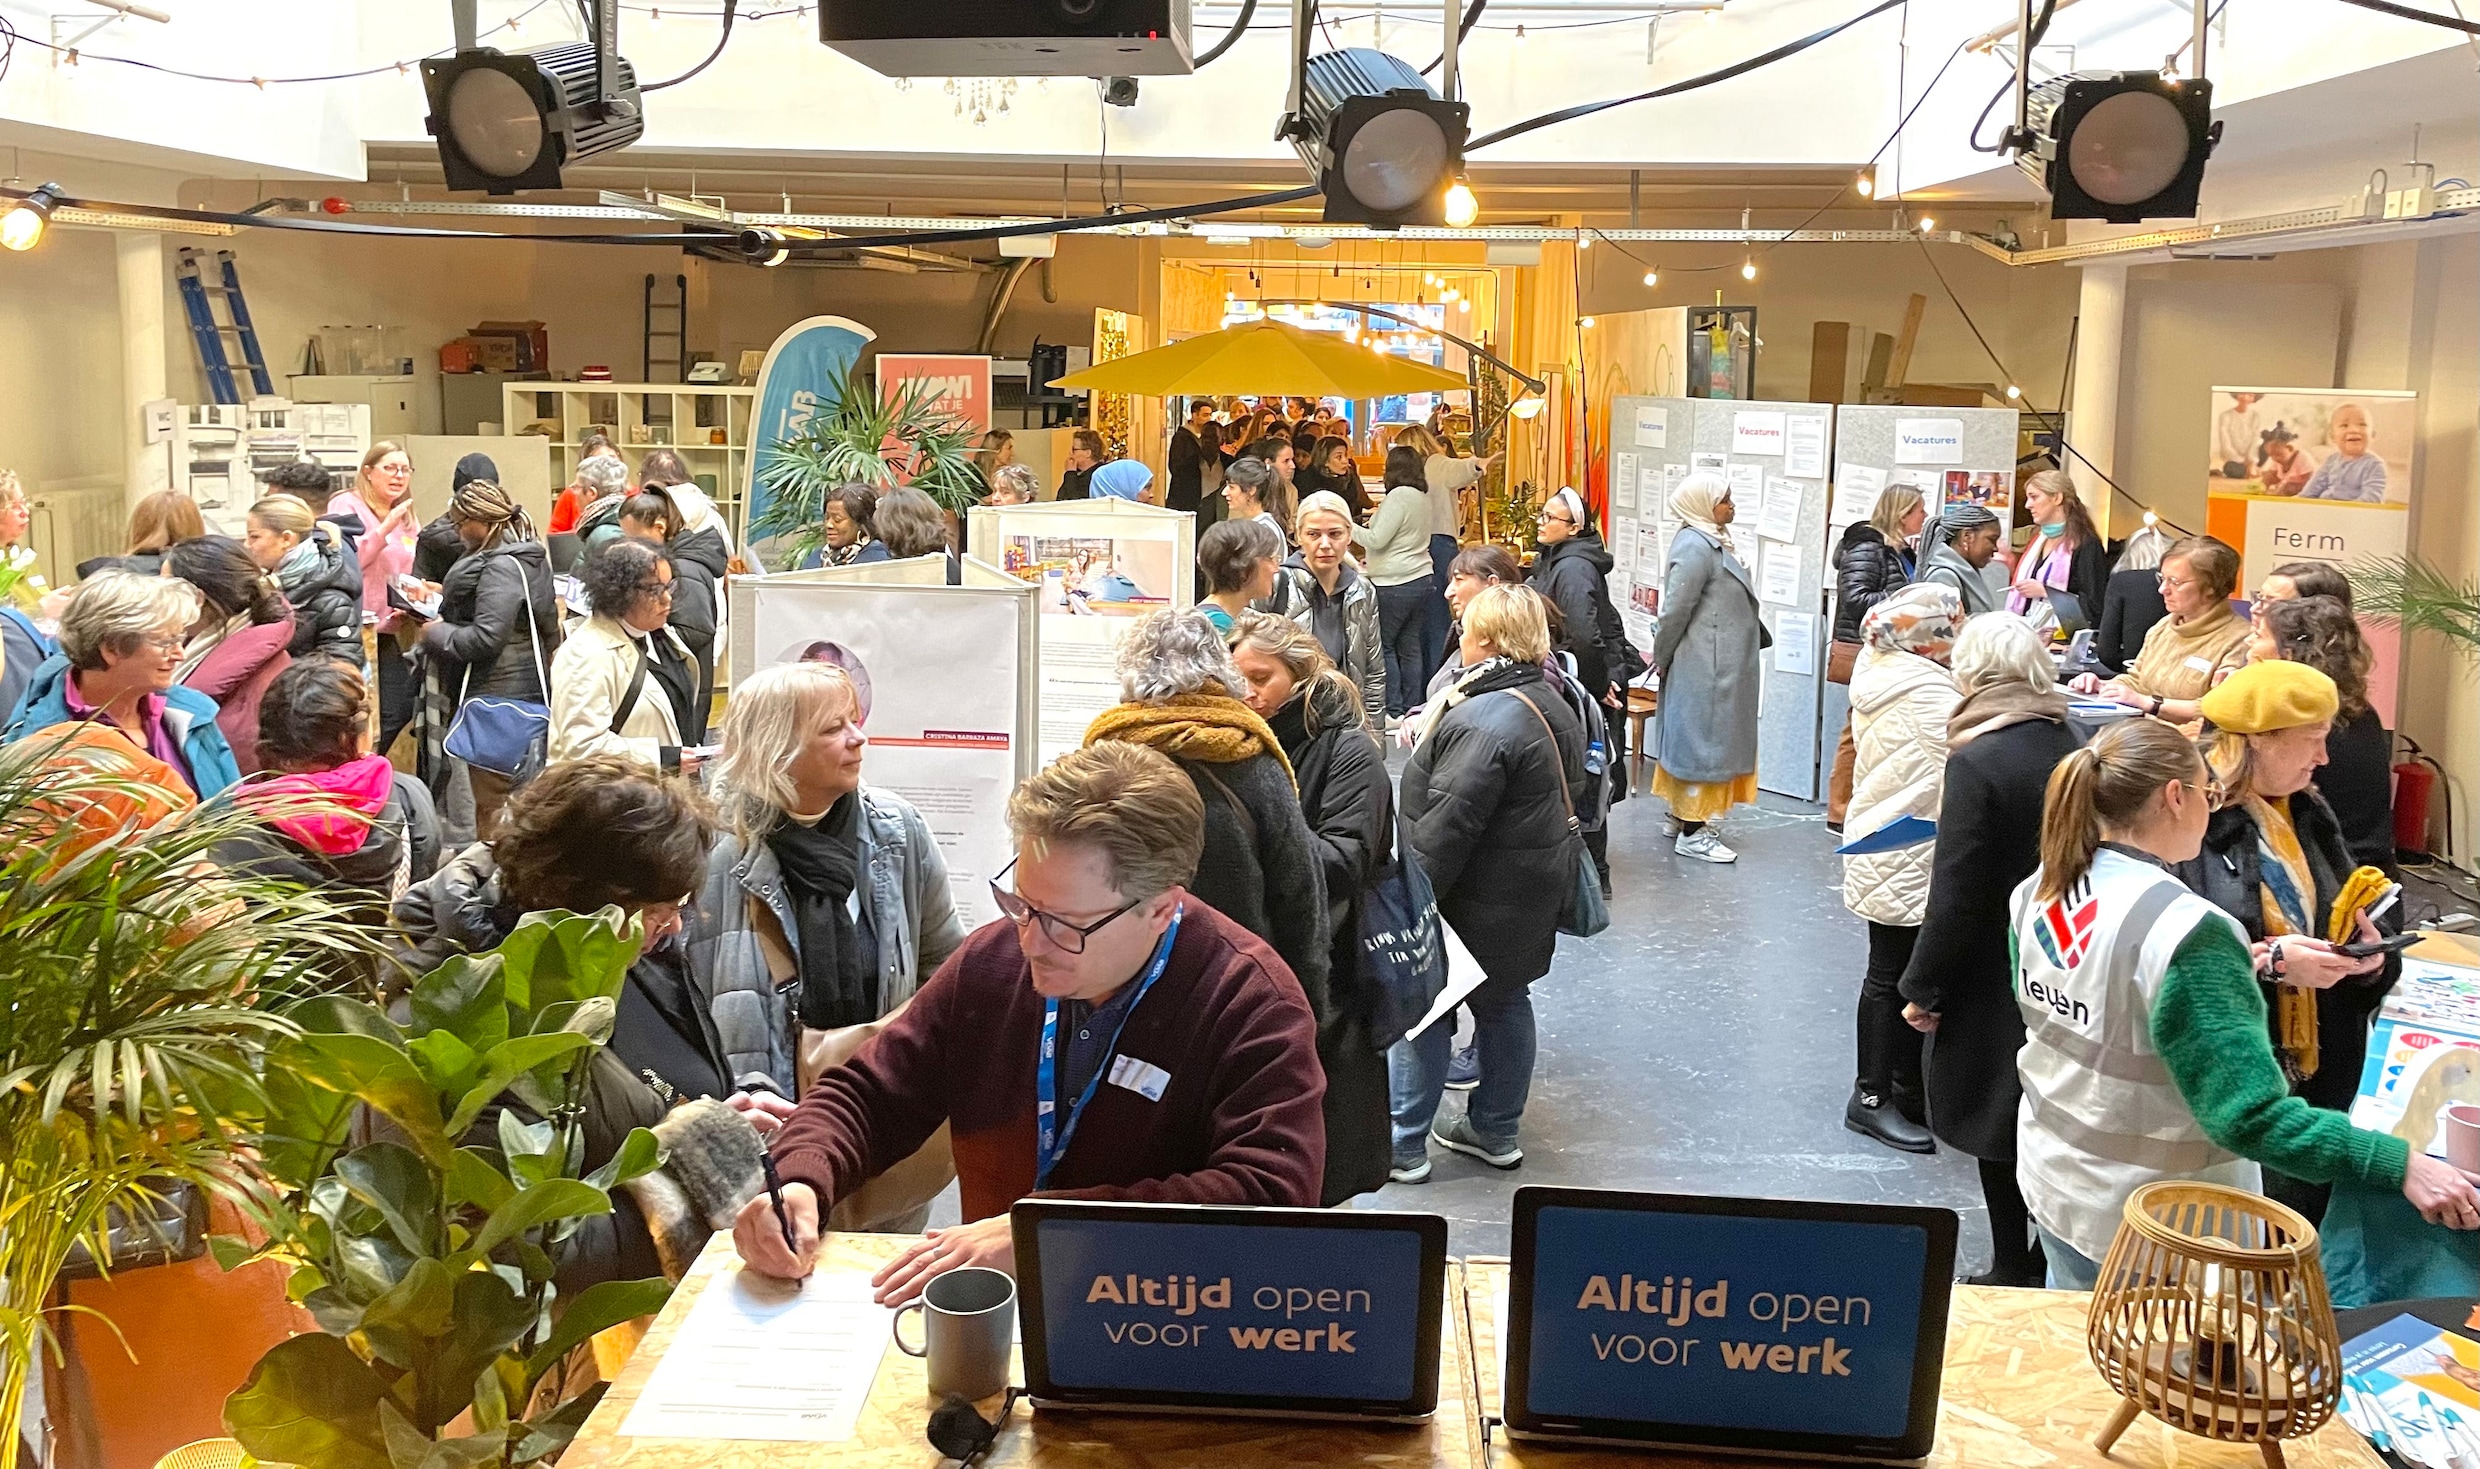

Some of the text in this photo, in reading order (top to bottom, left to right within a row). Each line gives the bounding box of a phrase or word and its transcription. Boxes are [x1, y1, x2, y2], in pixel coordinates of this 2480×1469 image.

[1638, 420, 1664, 431] Vacatures
[1738, 426, 1780, 437] Vacatures
[1903, 435, 1957, 446] Vacatures
[2274, 527, 2345, 551] Ferm
[1086, 1273, 1372, 1319] Altijd open
[1576, 1273, 1872, 1333] Altijd open
[1104, 1321, 1357, 1354] voor werk
[1591, 1333, 1852, 1377] voor werk
